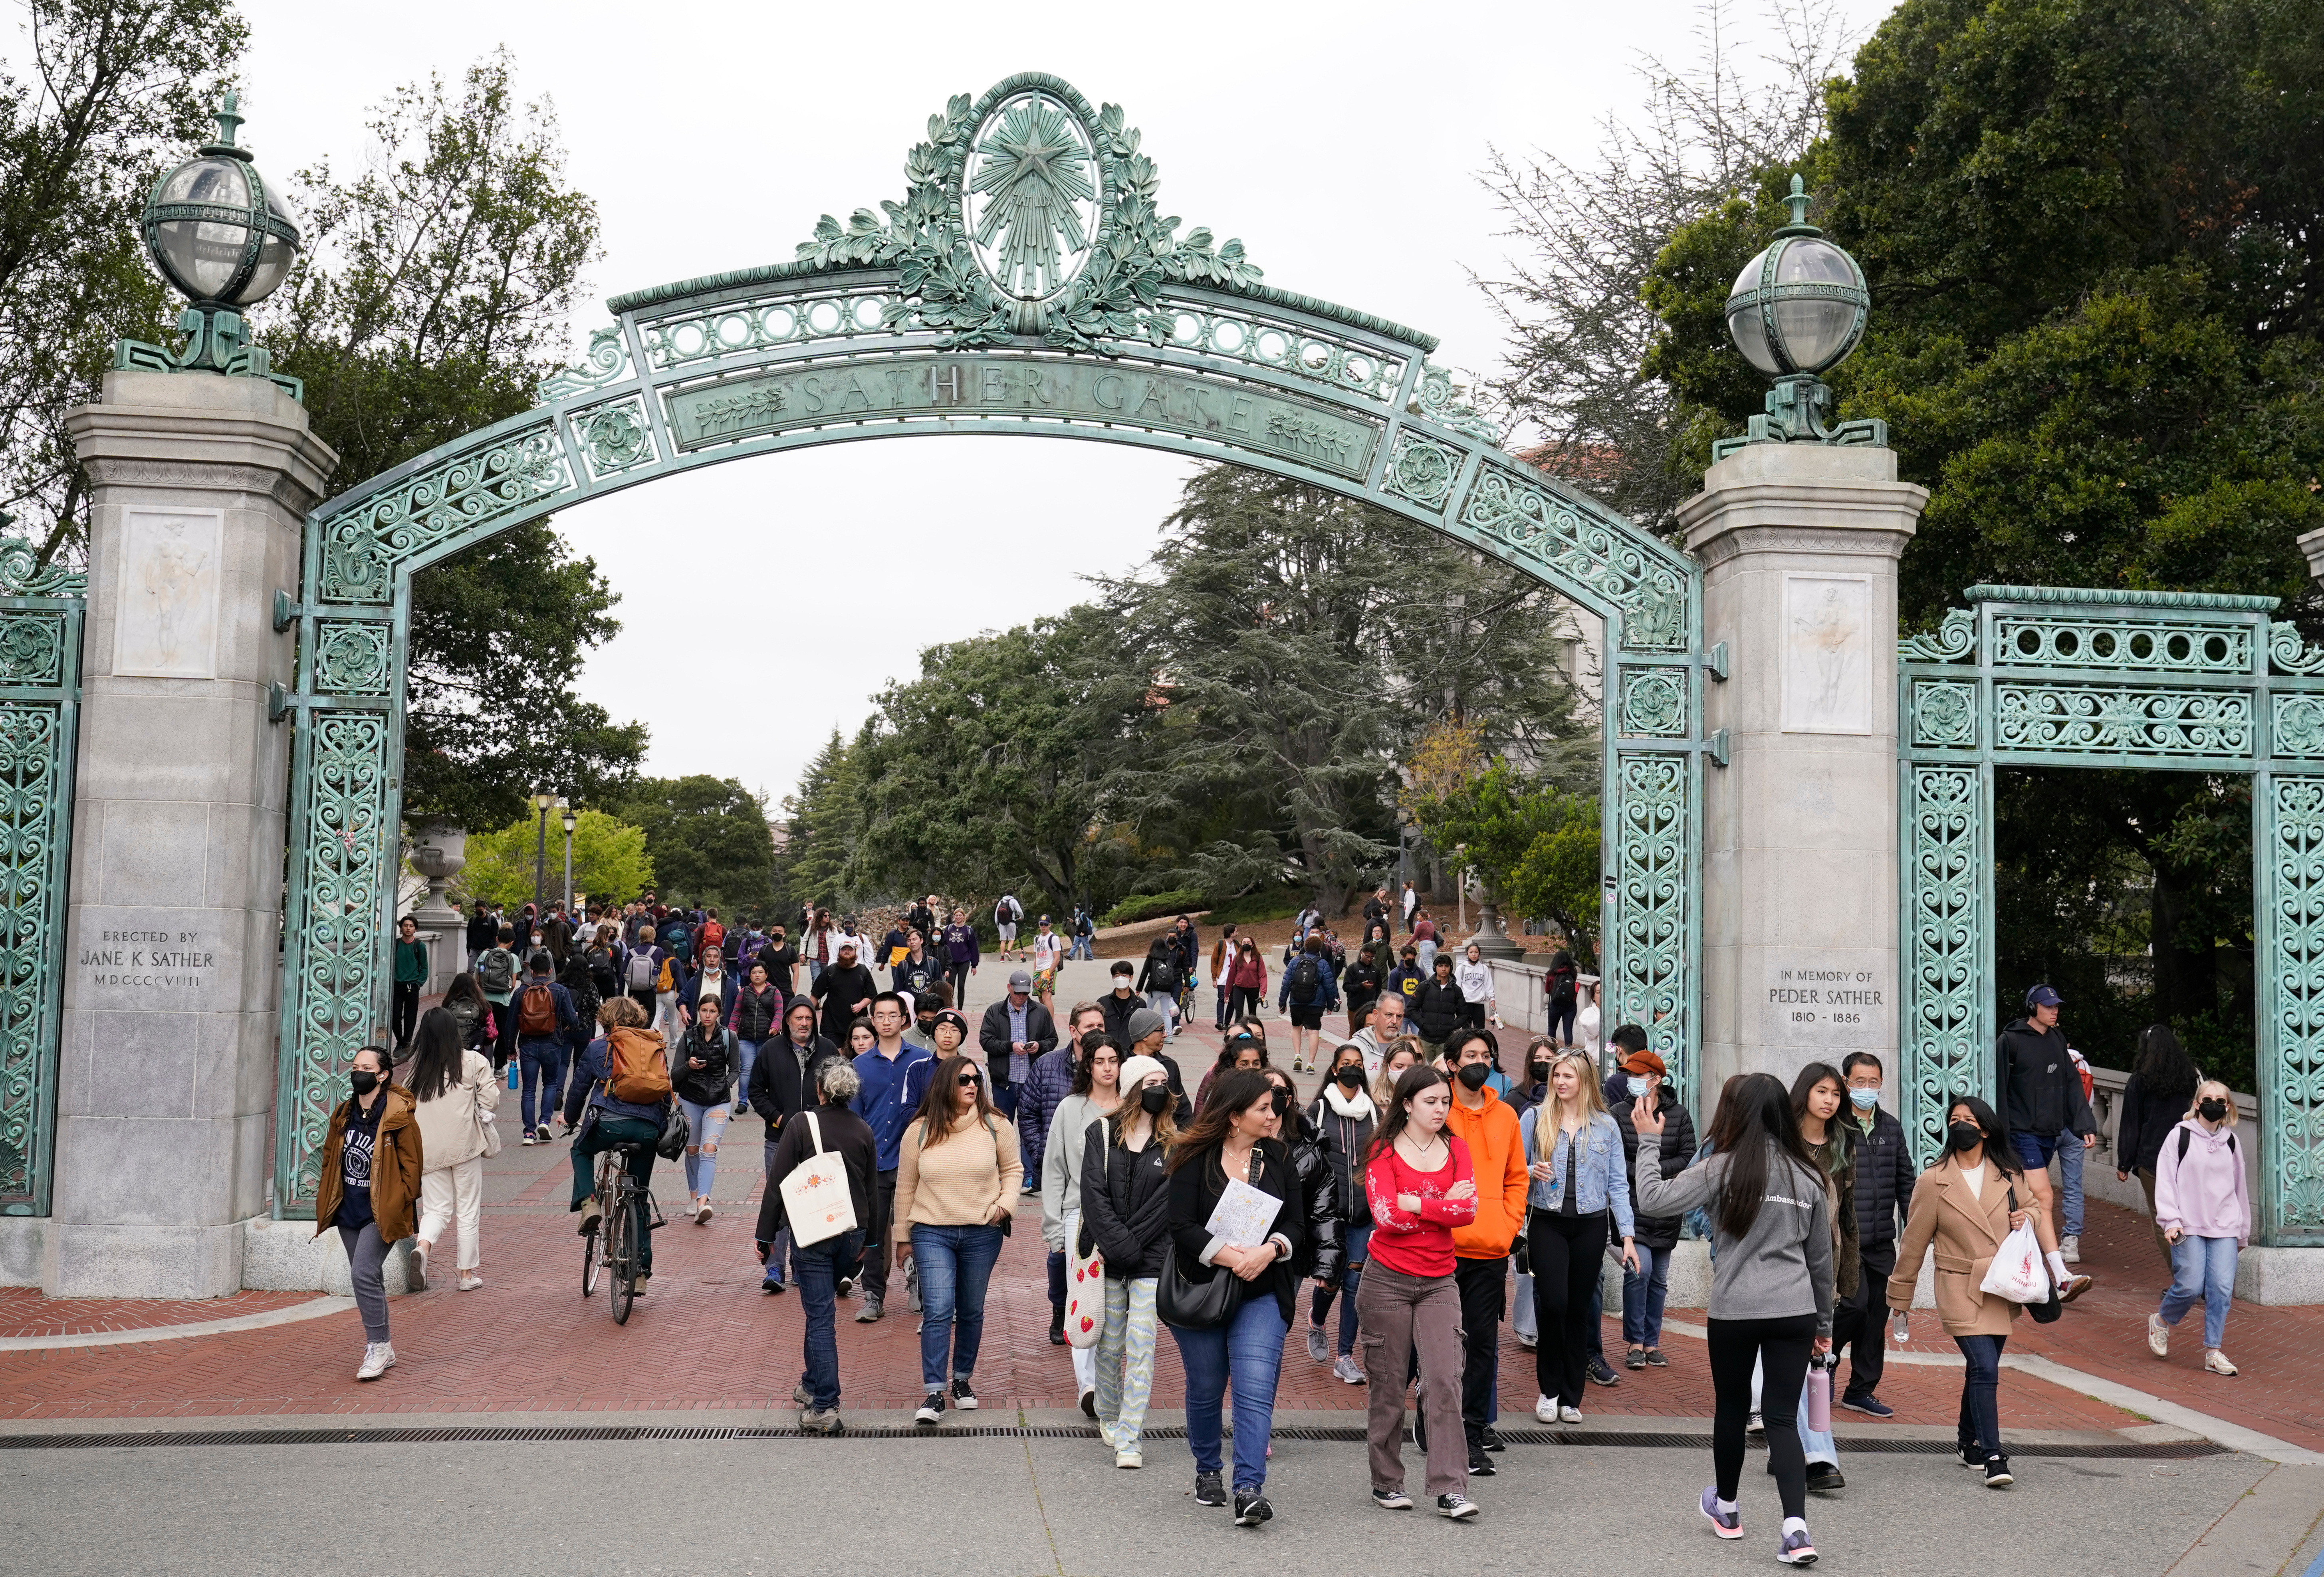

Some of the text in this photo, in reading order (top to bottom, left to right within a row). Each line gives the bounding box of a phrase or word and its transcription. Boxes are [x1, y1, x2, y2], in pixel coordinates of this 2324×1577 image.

[803, 365, 1253, 433] SATHER GATE
[102, 931, 198, 942] ERECTED BY
[81, 951, 215, 967] JANE K SATHER
[908, 970, 930, 980] MERRIMACK
[1781, 971, 1872, 982] IN MEMORY OF
[1770, 989, 1884, 1005] PEDER SATHER
[1792, 1012, 1815, 1022] 1810
[1833, 1013, 1860, 1023] 1886
[1368, 1062, 1379, 1070] A
[1765, 1194, 1812, 1210] Ambassador
[2012, 1274, 2028, 1288] HANK
